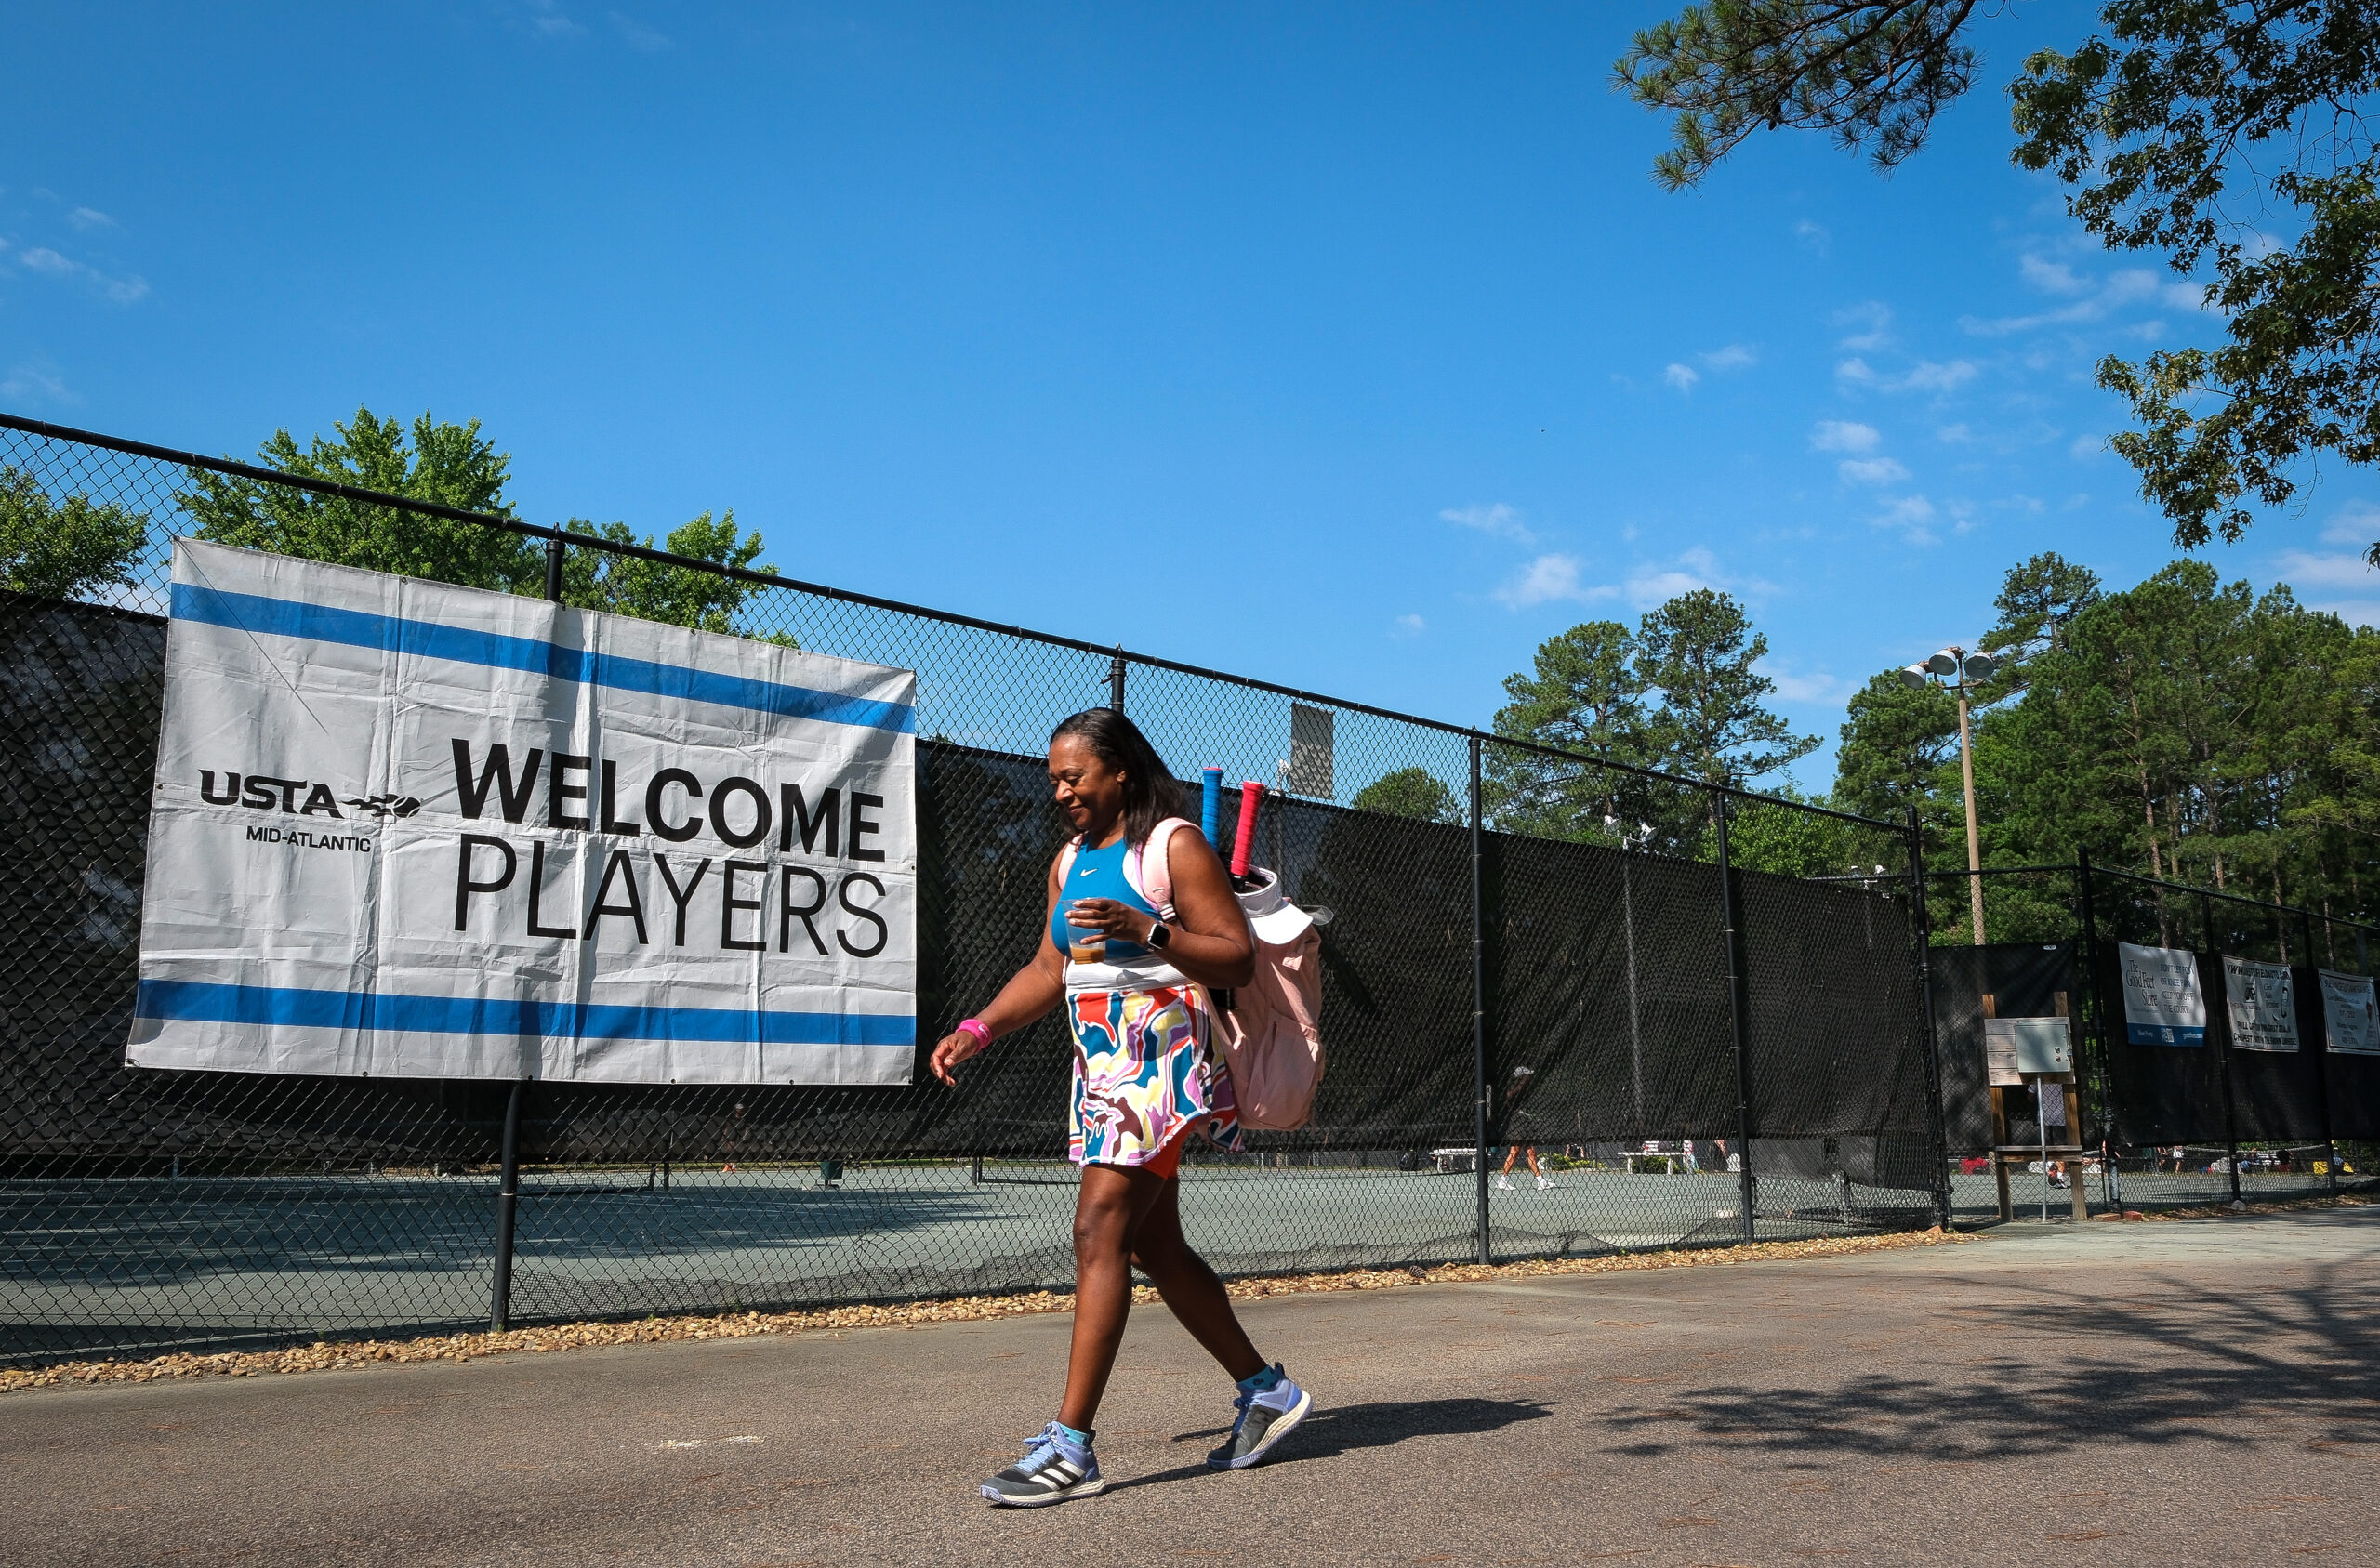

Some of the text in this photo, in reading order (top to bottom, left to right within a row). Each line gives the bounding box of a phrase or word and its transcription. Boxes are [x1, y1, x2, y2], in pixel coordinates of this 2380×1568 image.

[198, 770, 345, 819] USTA
[451, 738, 886, 863] WELCOME
[246, 825, 371, 852] MID-ATLANTIC
[454, 833, 889, 959] PLAYERS
[2126, 969, 2156, 989] Good Feet
[2128, 959, 2138, 972] The
[2142, 989, 2158, 1006] Store
